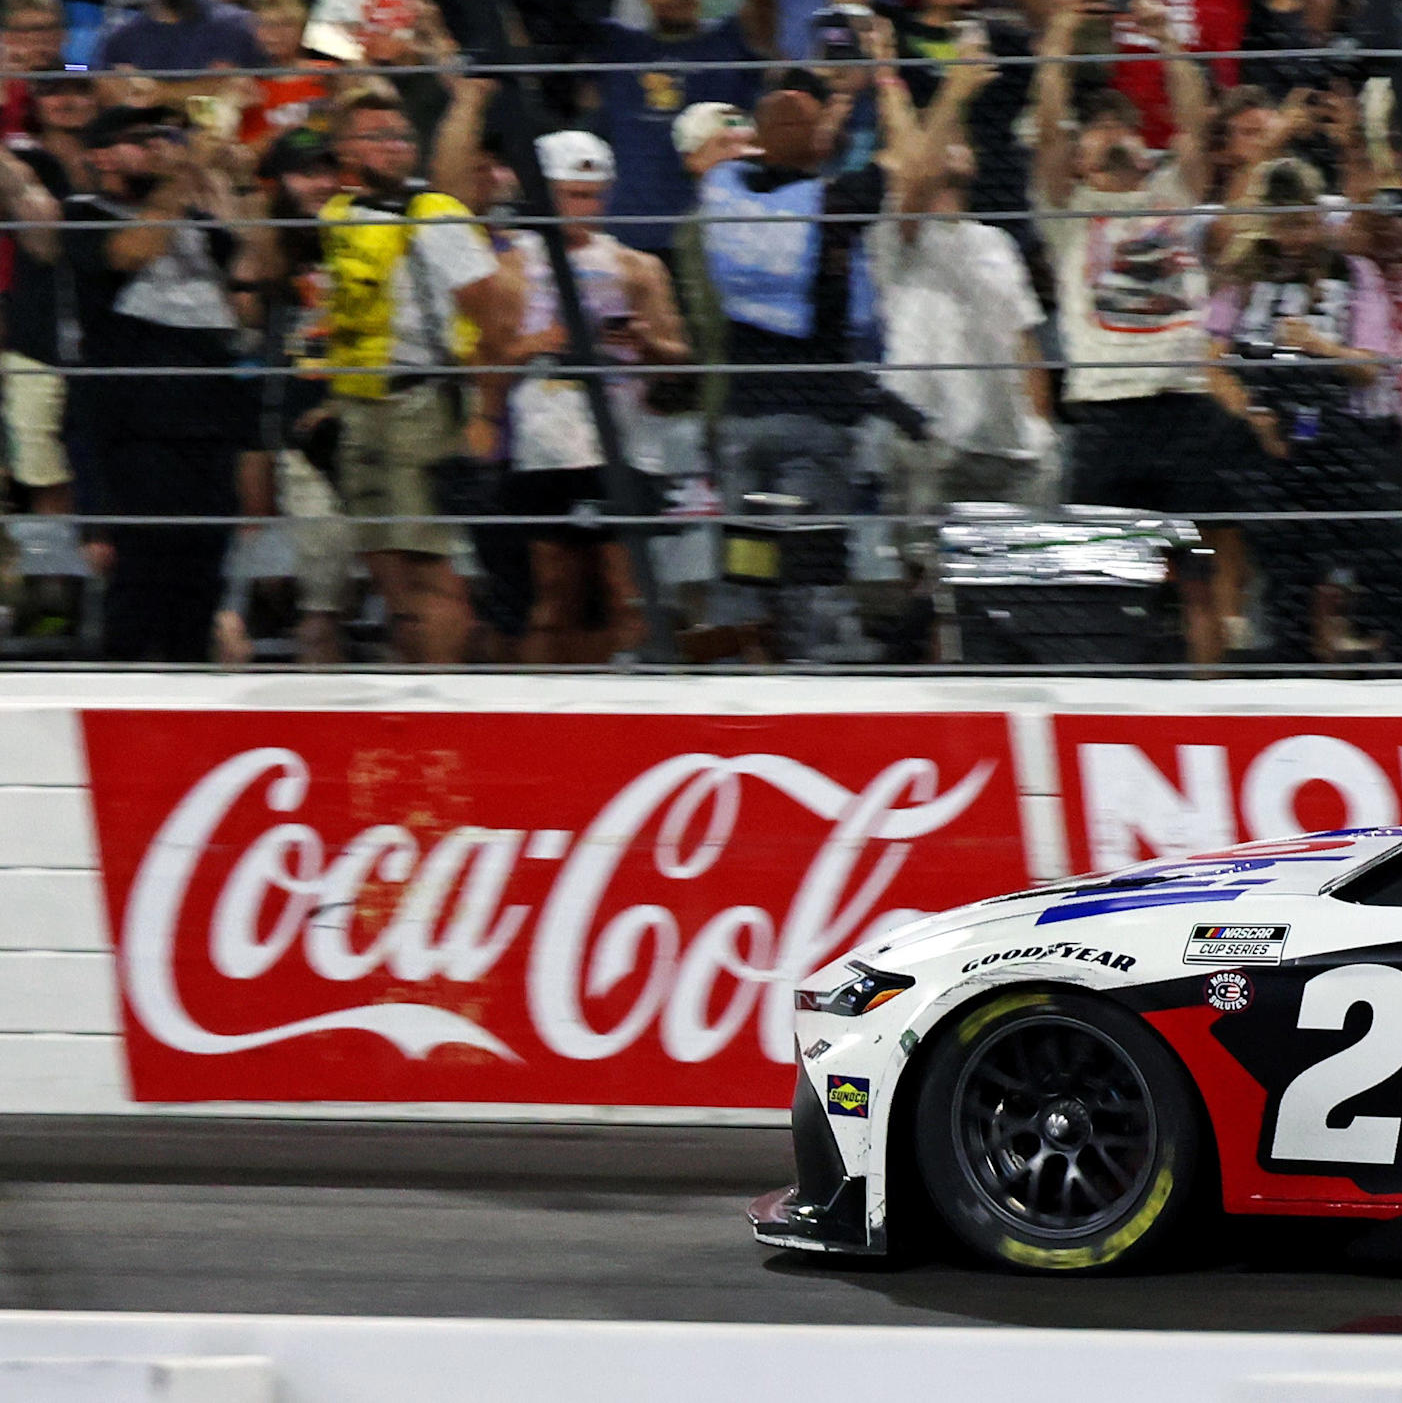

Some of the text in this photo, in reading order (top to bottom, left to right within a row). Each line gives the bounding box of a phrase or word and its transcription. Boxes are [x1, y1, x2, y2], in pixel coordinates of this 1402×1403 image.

[1221, 928, 1275, 938] NASCAR
[1200, 943, 1270, 955] CUP SERIES
[961, 942, 1137, 973] GOODYEAR
[1210, 973, 1247, 989] NASCAR
[1208, 995, 1248, 1010] SALUTES
[830, 1090, 866, 1103] SUNOCO
